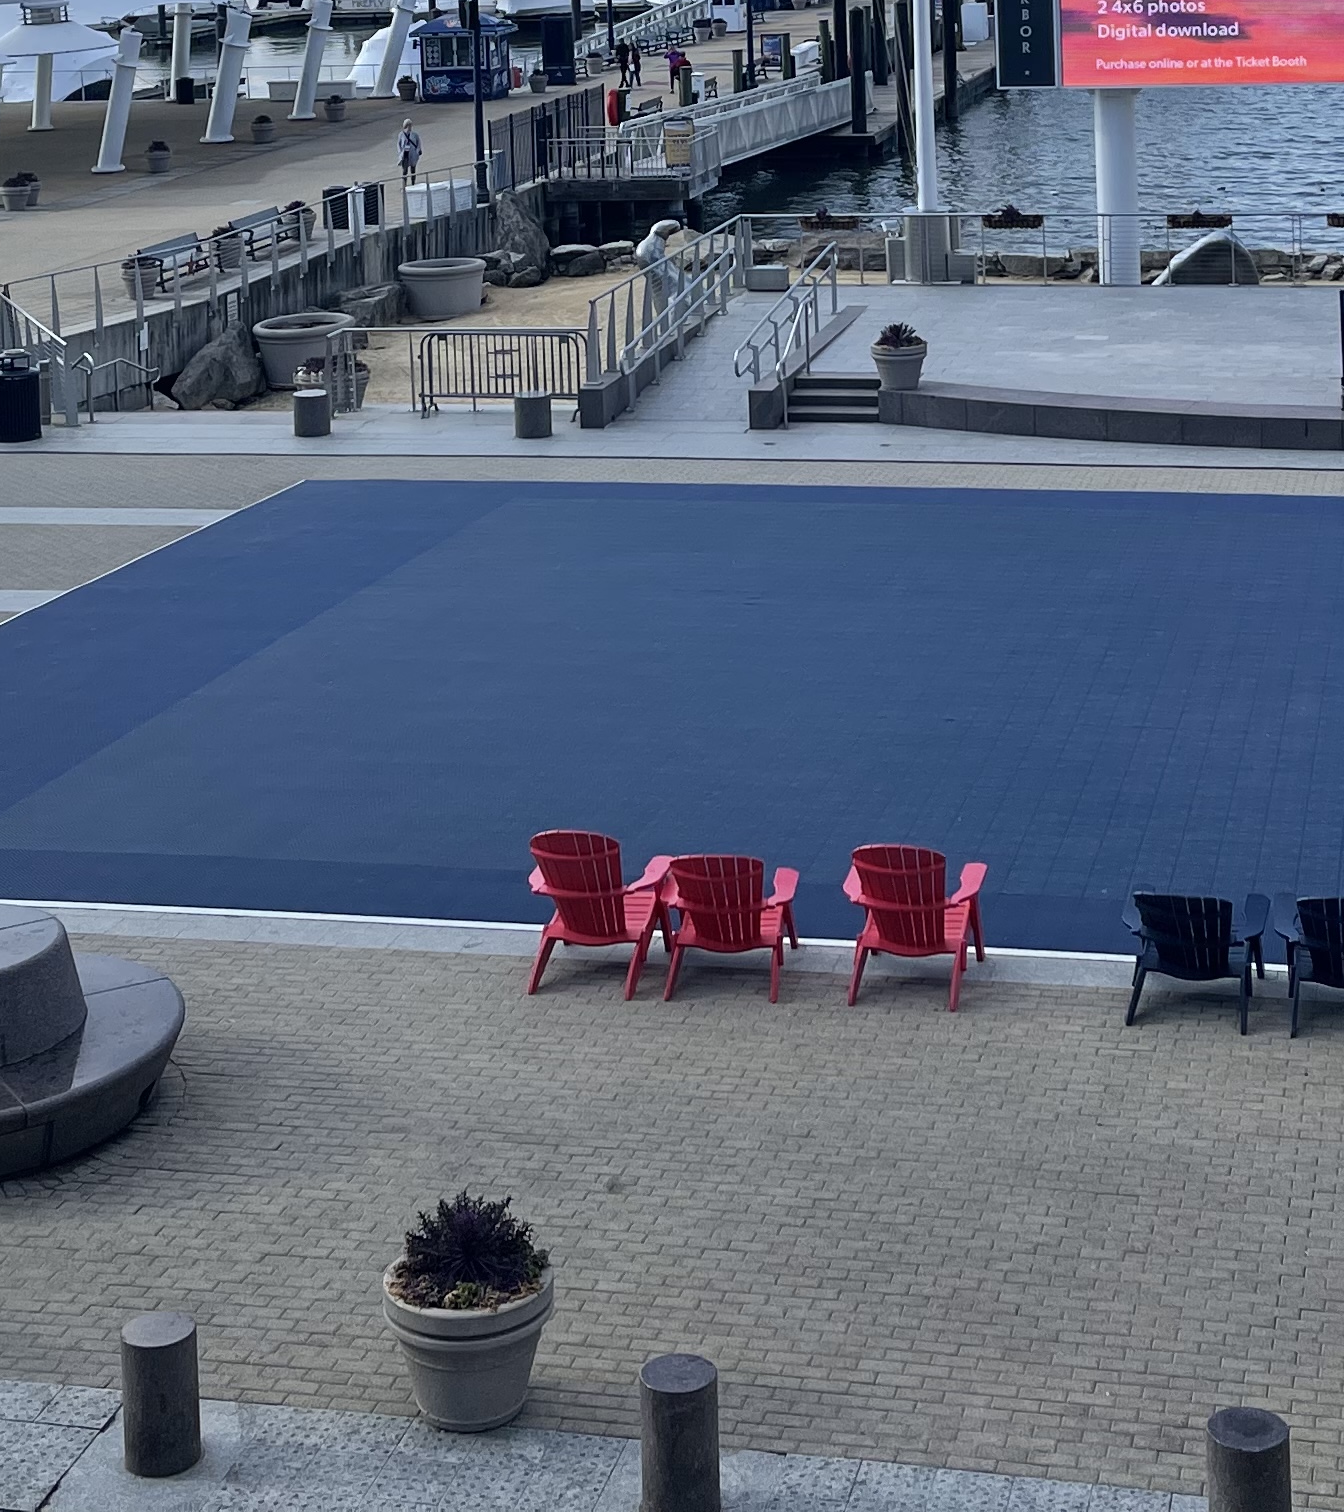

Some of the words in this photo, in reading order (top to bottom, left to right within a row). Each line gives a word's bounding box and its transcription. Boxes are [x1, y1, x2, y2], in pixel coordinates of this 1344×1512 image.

[1097, 0, 1107, 15] 2
[1111, 0, 1144, 14] 4x6
[1147, 0, 1206, 16] photos
[1097, 23, 1152, 41] Digital
[1155, 22, 1239, 38] download
[1096, 58, 1146, 70] Purchase
[1149, 57, 1184, 69] online
[1186, 58, 1198, 68] or
[1200, 57, 1212, 68] at
[1214, 56, 1233, 68] the
[1235, 55, 1270, 68] Ticket
[1272, 55, 1307, 68] Booth
